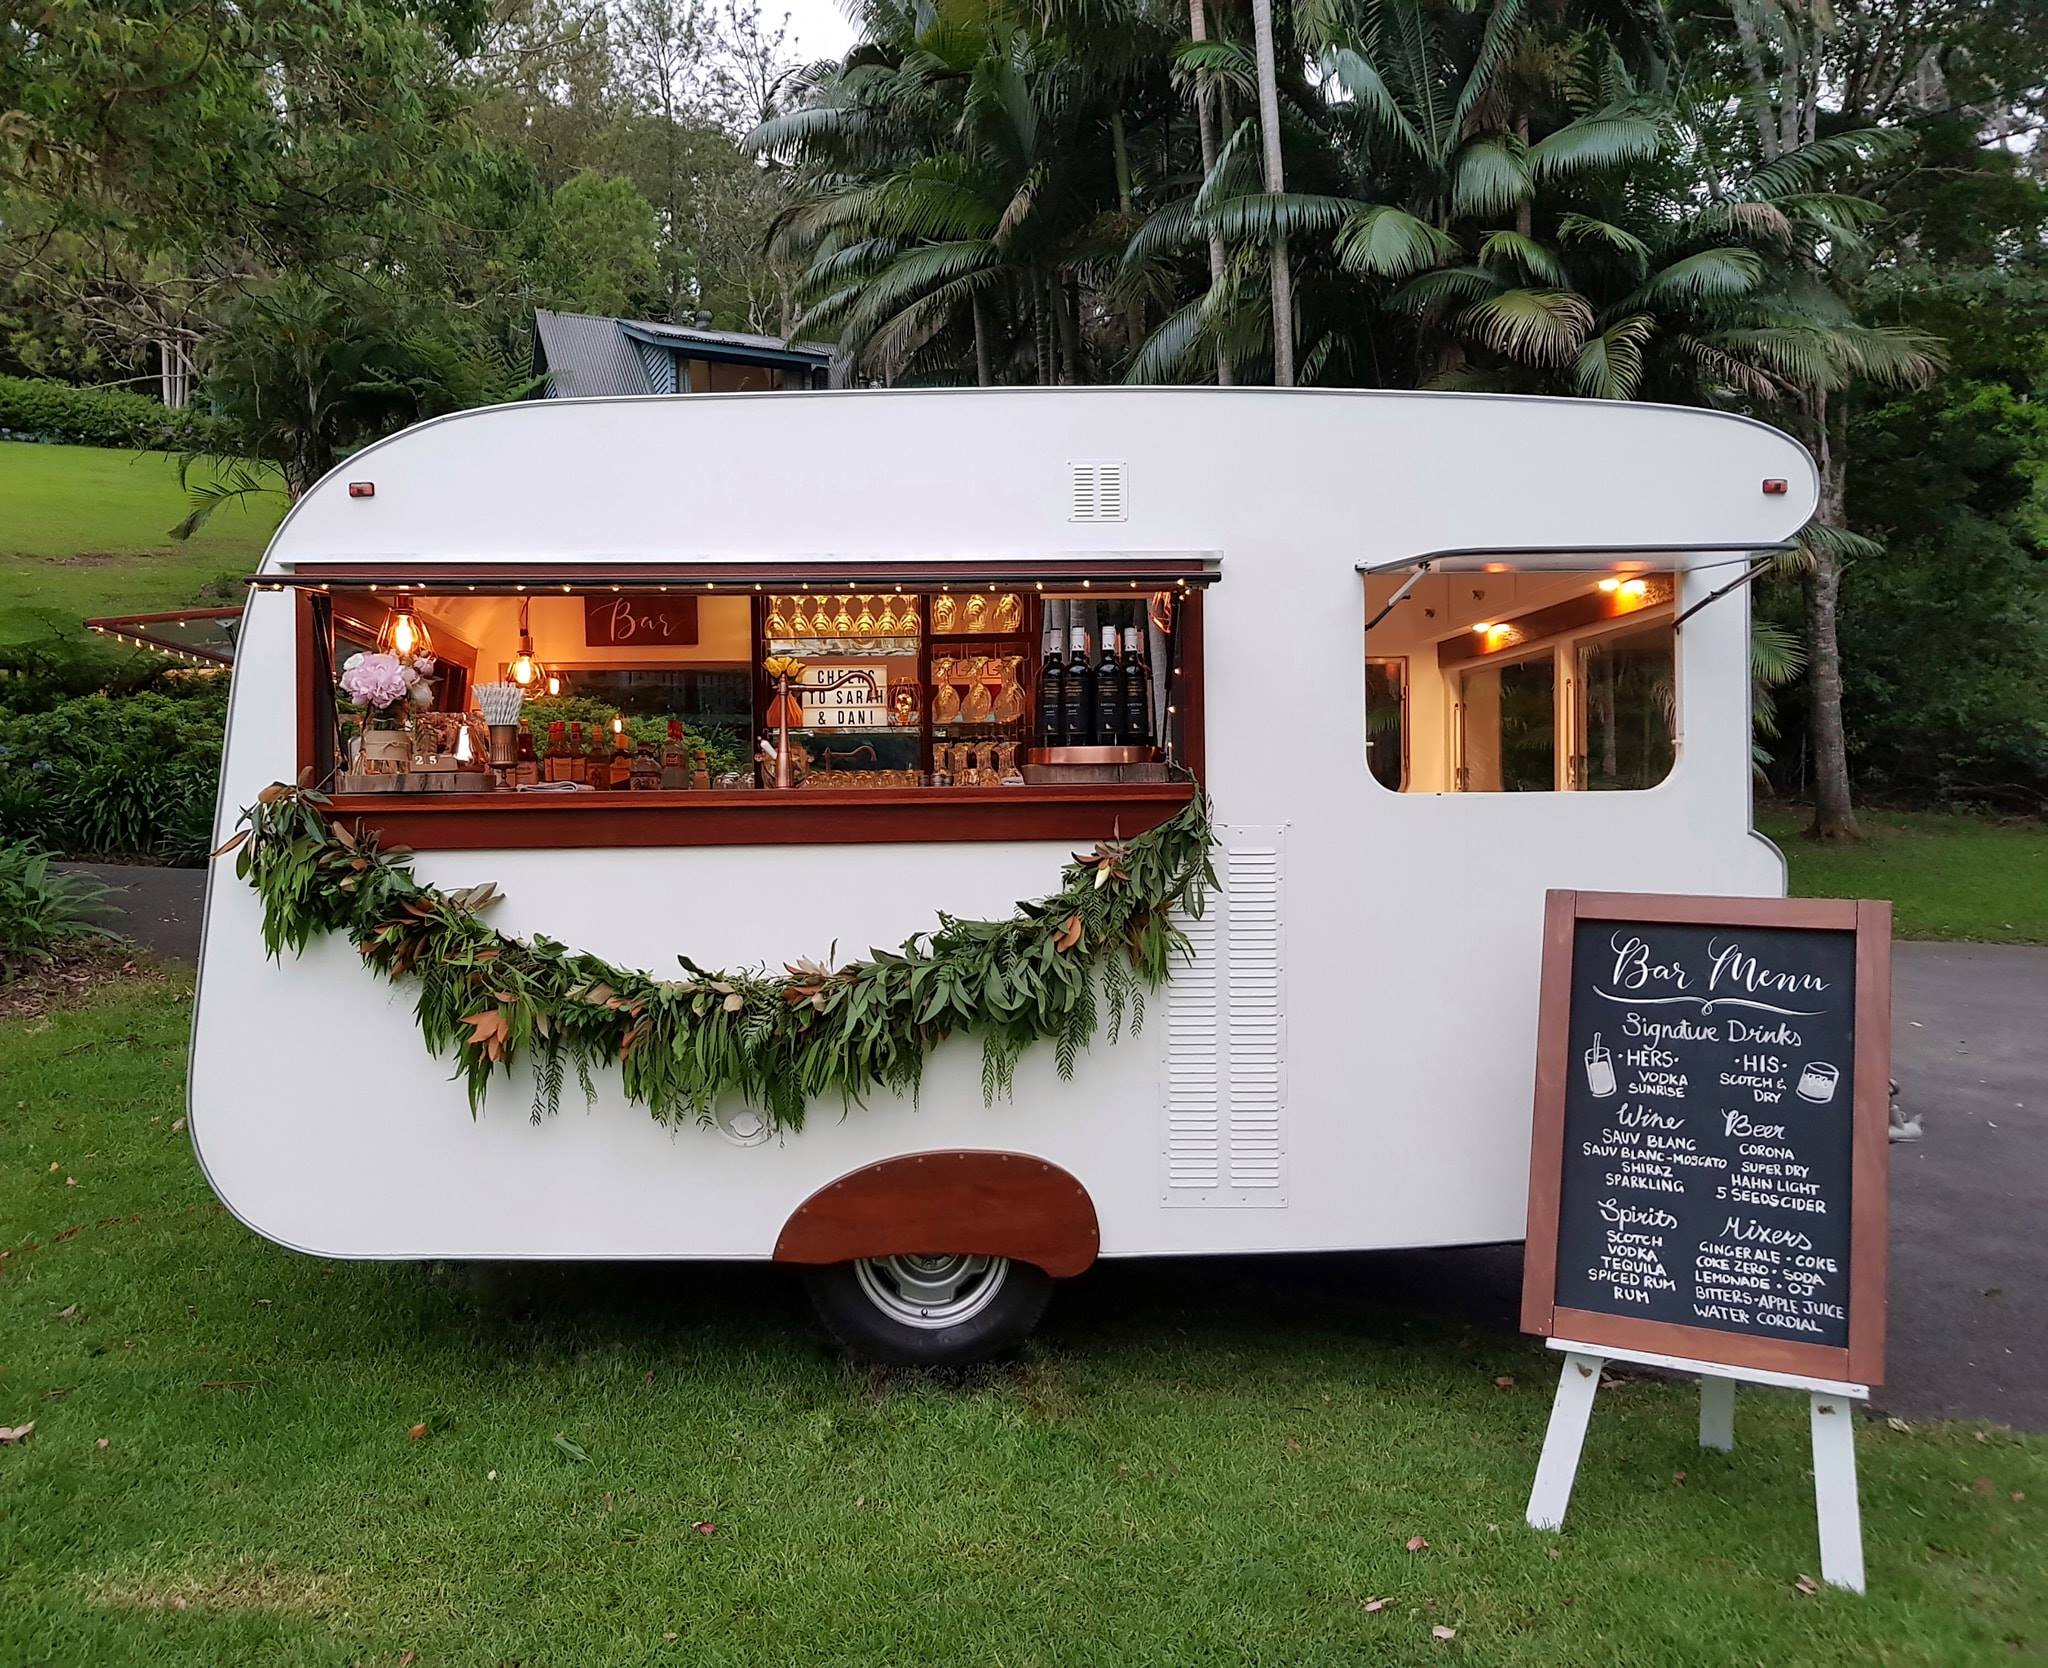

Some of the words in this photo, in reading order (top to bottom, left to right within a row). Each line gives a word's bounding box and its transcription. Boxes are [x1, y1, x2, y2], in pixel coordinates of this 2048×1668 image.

[590, 597, 681, 641] Bar
[809, 690, 826, 704] TO
[836, 689, 883, 705] SARAH
[818, 711, 826, 725] &
[838, 710, 873, 725] DAN!
[1610, 930, 1694, 990] Bar
[1707, 936, 1831, 993] Menu
[1622, 1011, 1720, 1051] Signature
[1727, 1018, 1802, 1047] Drinks
[1638, 1069, 1688, 1086] VODKA
[1719, 1072, 1773, 1089] SCOTCH
[1776, 1077, 1788, 1091] &
[1627, 1082, 1686, 1098] SUNRISE
[1753, 1090, 1782, 1104] DRY
[1616, 1102, 1687, 1130] Wine
[1720, 1107, 1785, 1140] Beer
[1582, 1142, 1618, 1157] SAUV
[1602, 1128, 1640, 1145] SAUV
[1647, 1135, 1697, 1151] BLANC
[1739, 1142, 1795, 1160] CORONA
[1621, 1161, 1674, 1178] SHIRAZ
[1740, 1161, 1782, 1176] SUPER
[1784, 1164, 1810, 1178] DRY
[1605, 1172, 1685, 1194] SPARKLING
[1715, 1186, 1728, 1199] 5
[1731, 1173, 1773, 1190] HAHN
[1776, 1180, 1821, 1196] LIGHT
[1597, 1197, 1678, 1231] Spirits
[1606, 1229, 1663, 1247] SCOTCH
[1719, 1216, 1813, 1251] Mixers
[1607, 1243, 1659, 1263] VODKA
[1699, 1241, 1752, 1260] GINGER
[1753, 1248, 1781, 1265] ALE
[1795, 1254, 1838, 1273] COKE
[1600, 1255, 1667, 1277] TEQUILA
[1695, 1255, 1731, 1271] COKE
[1733, 1260, 1769, 1276] ZERO
[1782, 1268, 1827, 1286] SODA
[1587, 1267, 1641, 1286] SPICED
[1643, 1275, 1677, 1292] RUM
[1695, 1269, 1771, 1290] LEMONADE
[1787, 1282, 1815, 1297] OJ
[1613, 1285, 1650, 1305] RUM
[1802, 1300, 1846, 1320] JUICE
[1756, 1311, 1824, 1333] CORDIAL
